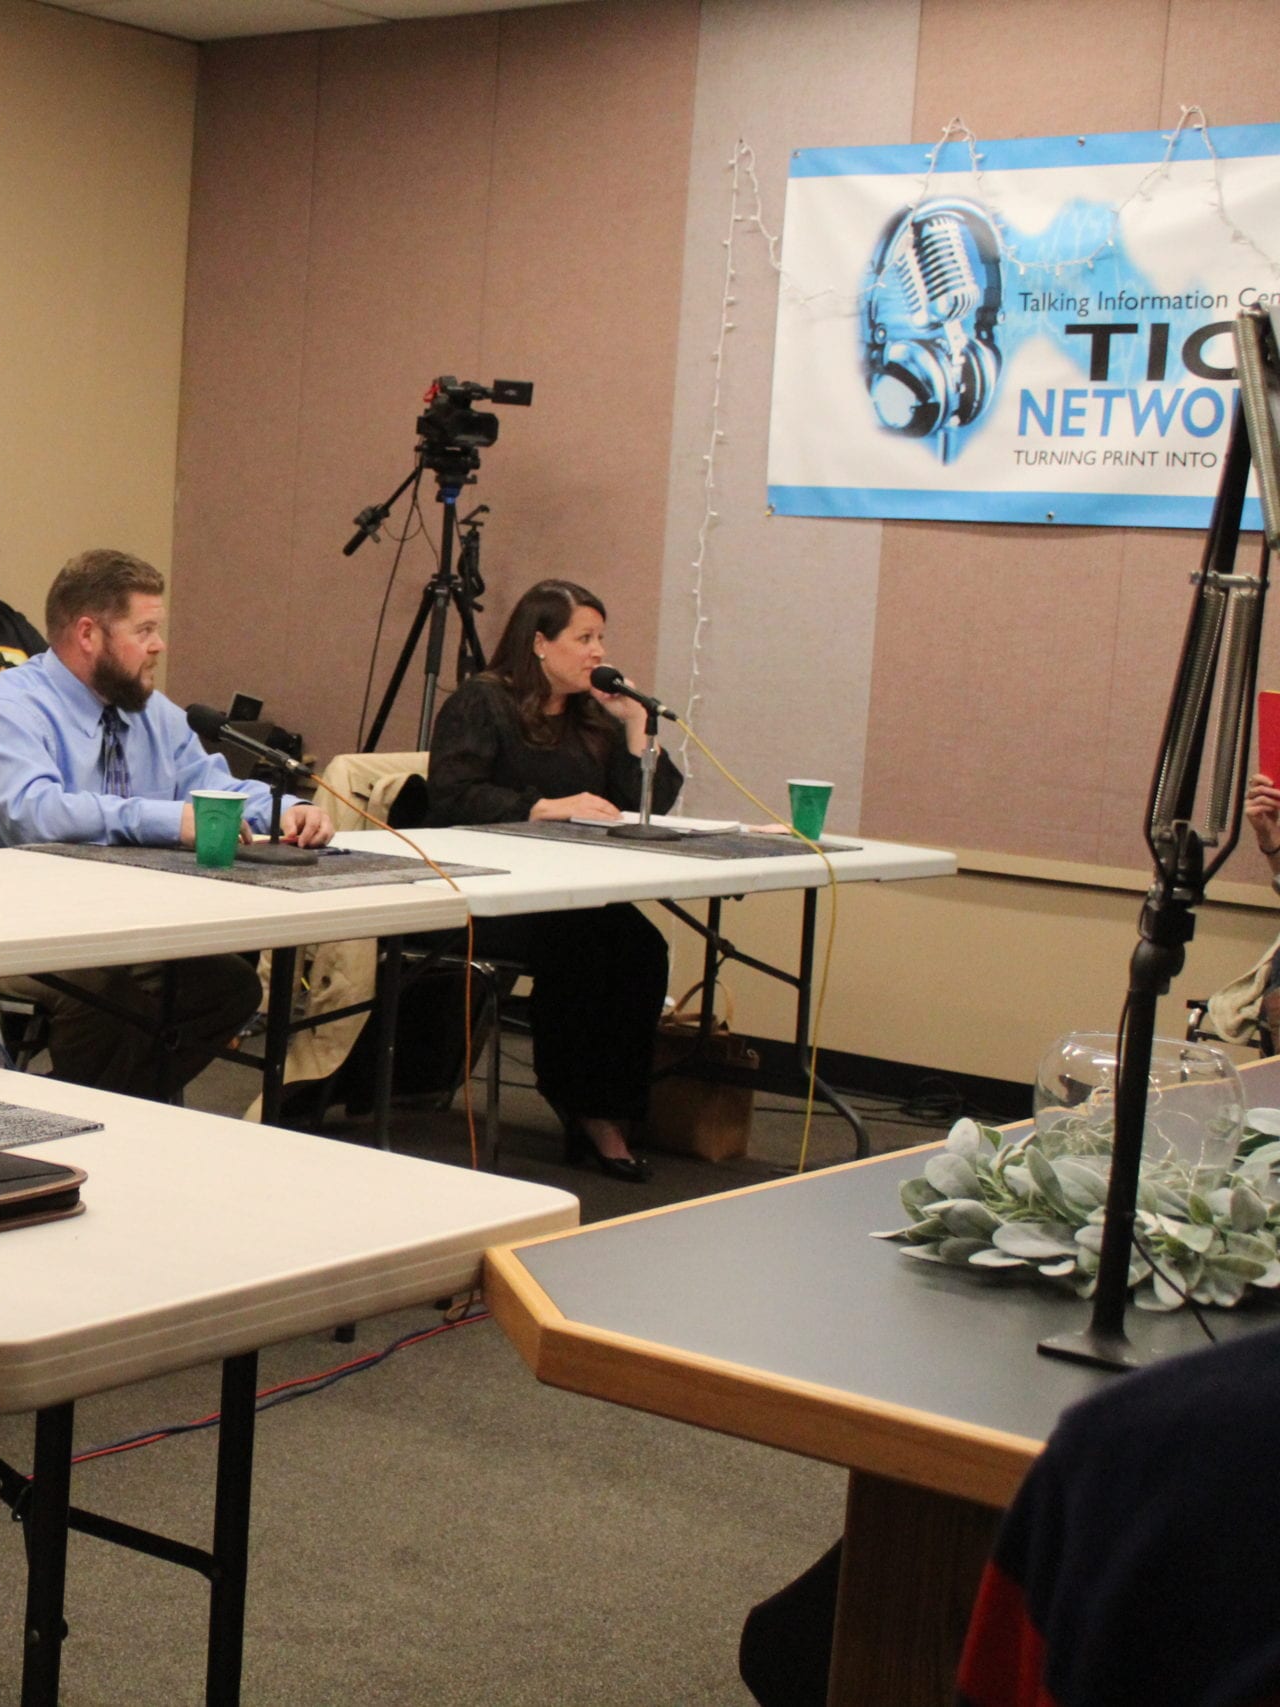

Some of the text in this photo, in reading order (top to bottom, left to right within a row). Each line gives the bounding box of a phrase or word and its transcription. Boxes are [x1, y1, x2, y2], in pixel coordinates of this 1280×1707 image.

[1018, 292, 1090, 317] Talking
[1098, 289, 1228, 310] Information
[1018, 387, 1241, 438] NETWO
[1013, 450, 1217, 468] TURNING PRINT INTO
